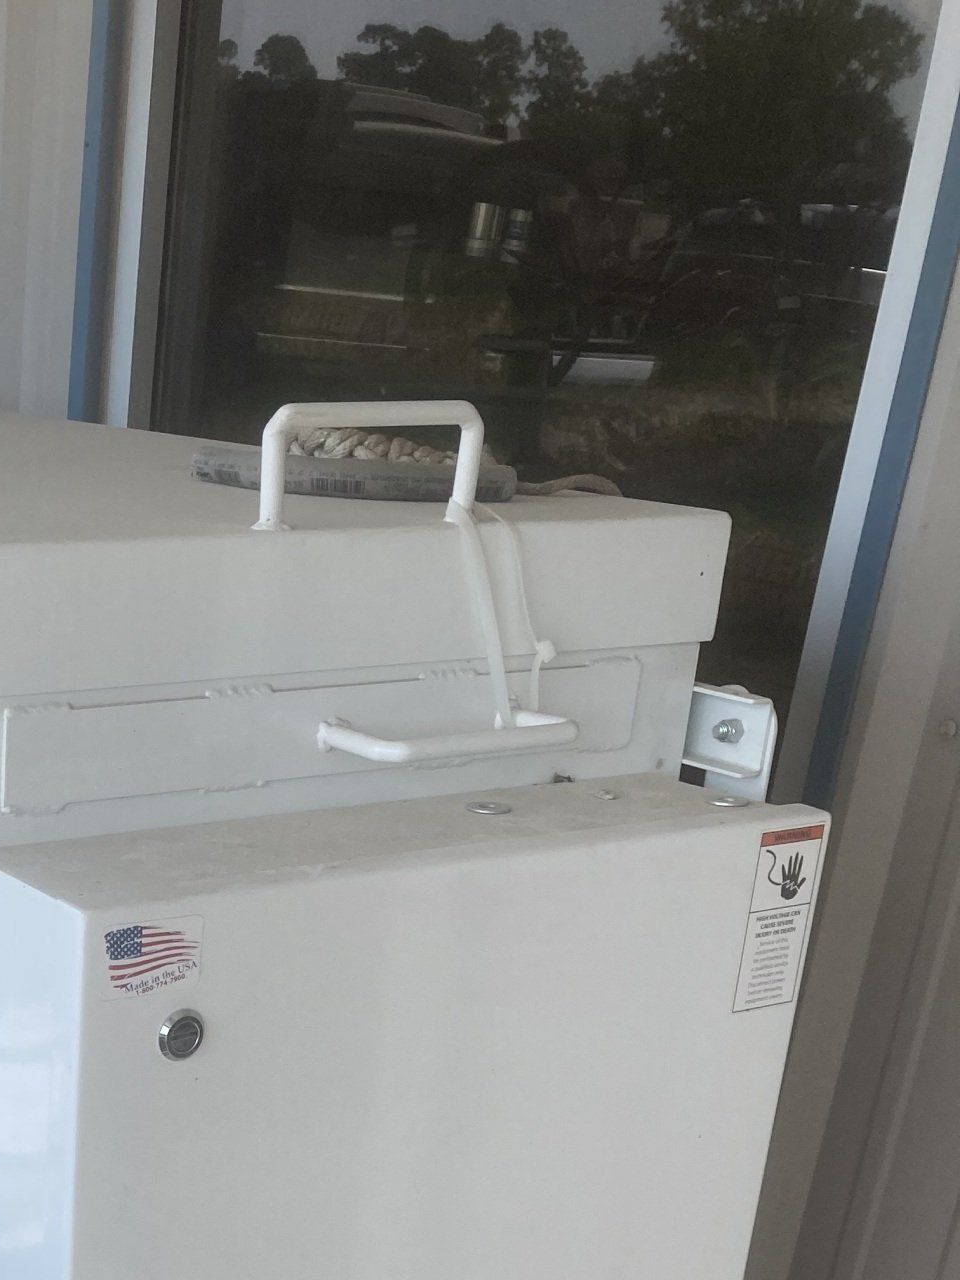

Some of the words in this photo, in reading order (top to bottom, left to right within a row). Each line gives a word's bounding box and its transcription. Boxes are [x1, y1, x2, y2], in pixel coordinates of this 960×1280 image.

[124, 979, 149, 993] Made
[151, 974, 161, 984] in
[162, 969, 176, 980] the
[178, 960, 198, 974] USA
